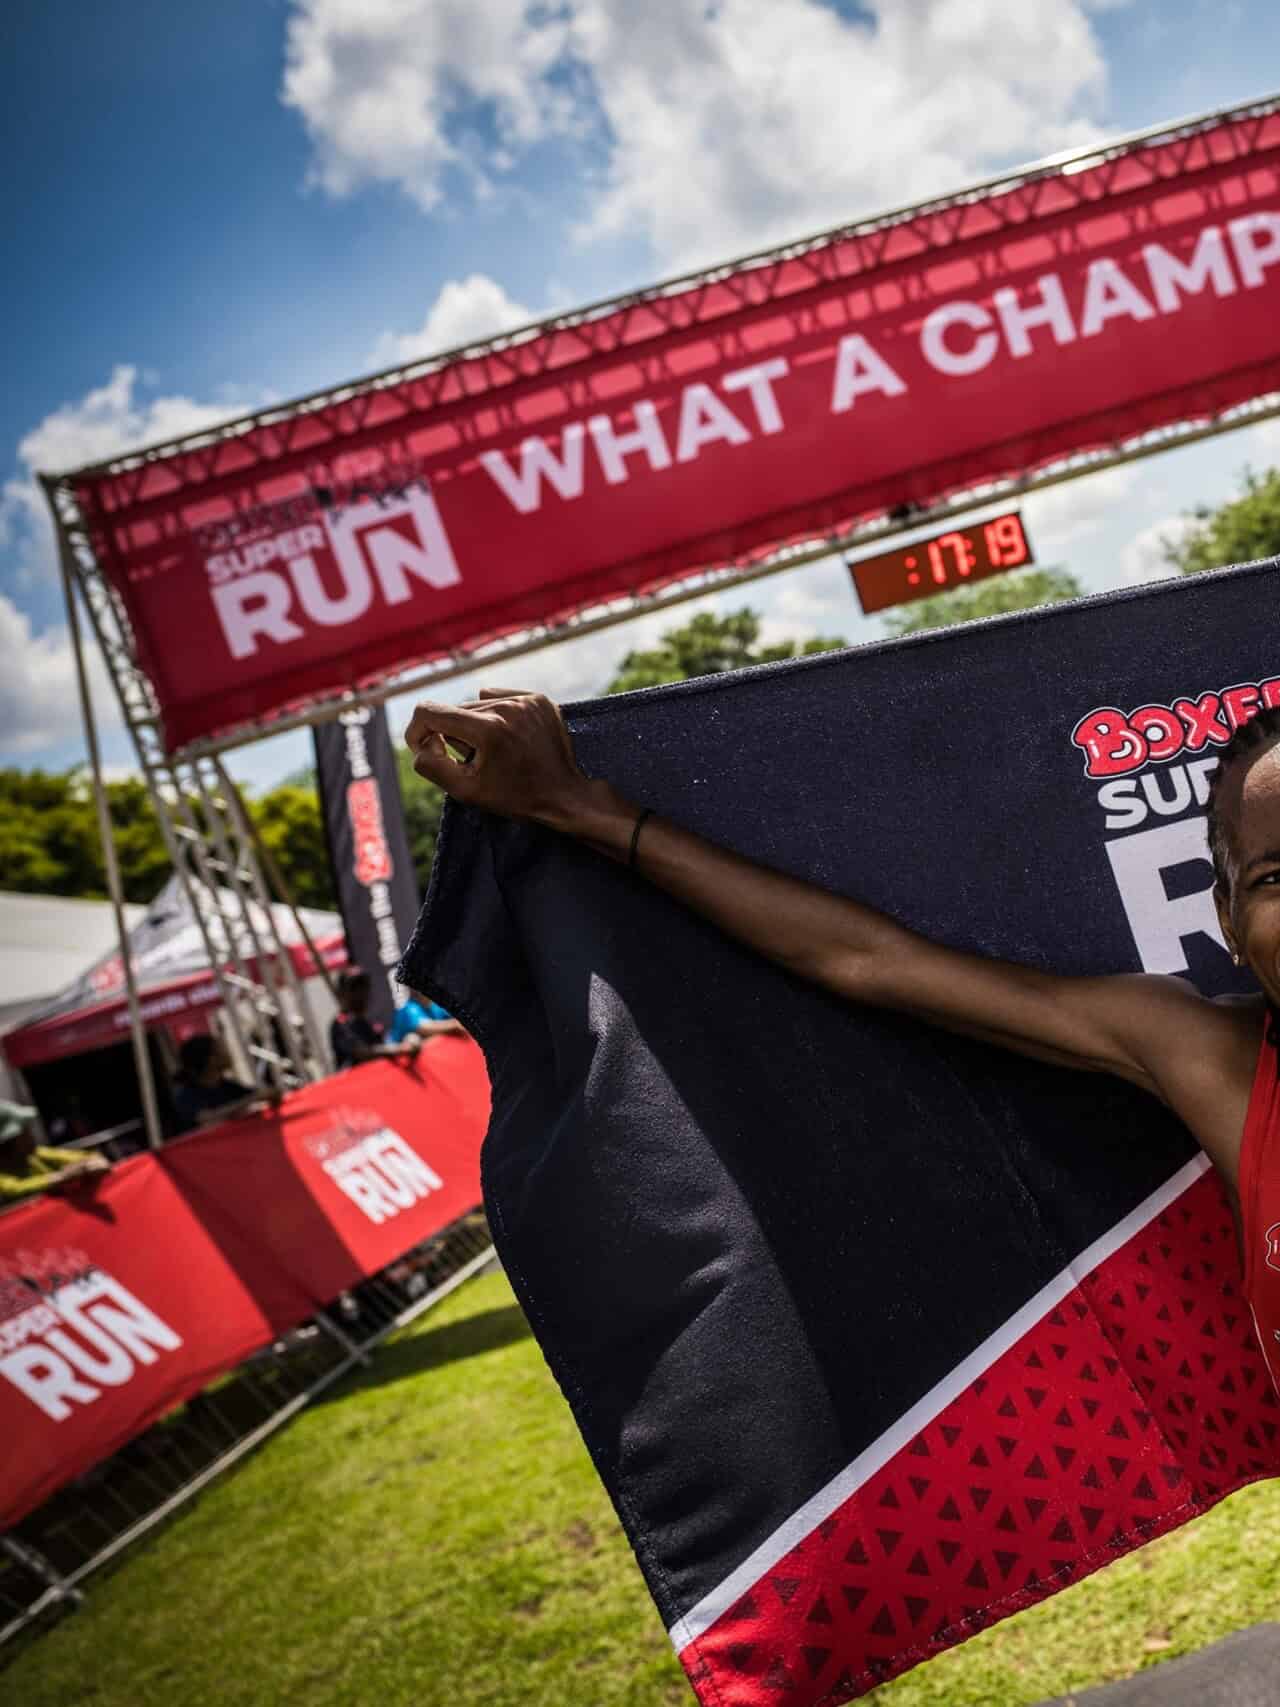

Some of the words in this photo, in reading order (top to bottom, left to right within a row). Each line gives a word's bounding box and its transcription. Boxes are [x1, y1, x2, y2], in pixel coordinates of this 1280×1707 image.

[479, 356, 790, 514] WHAT
[830, 332, 908, 415] A
[204, 523, 325, 585] SUPER
[210, 479, 464, 662] RUN
[1099, 756, 1220, 830] SUP
[0, 1269, 184, 1423] RUN
